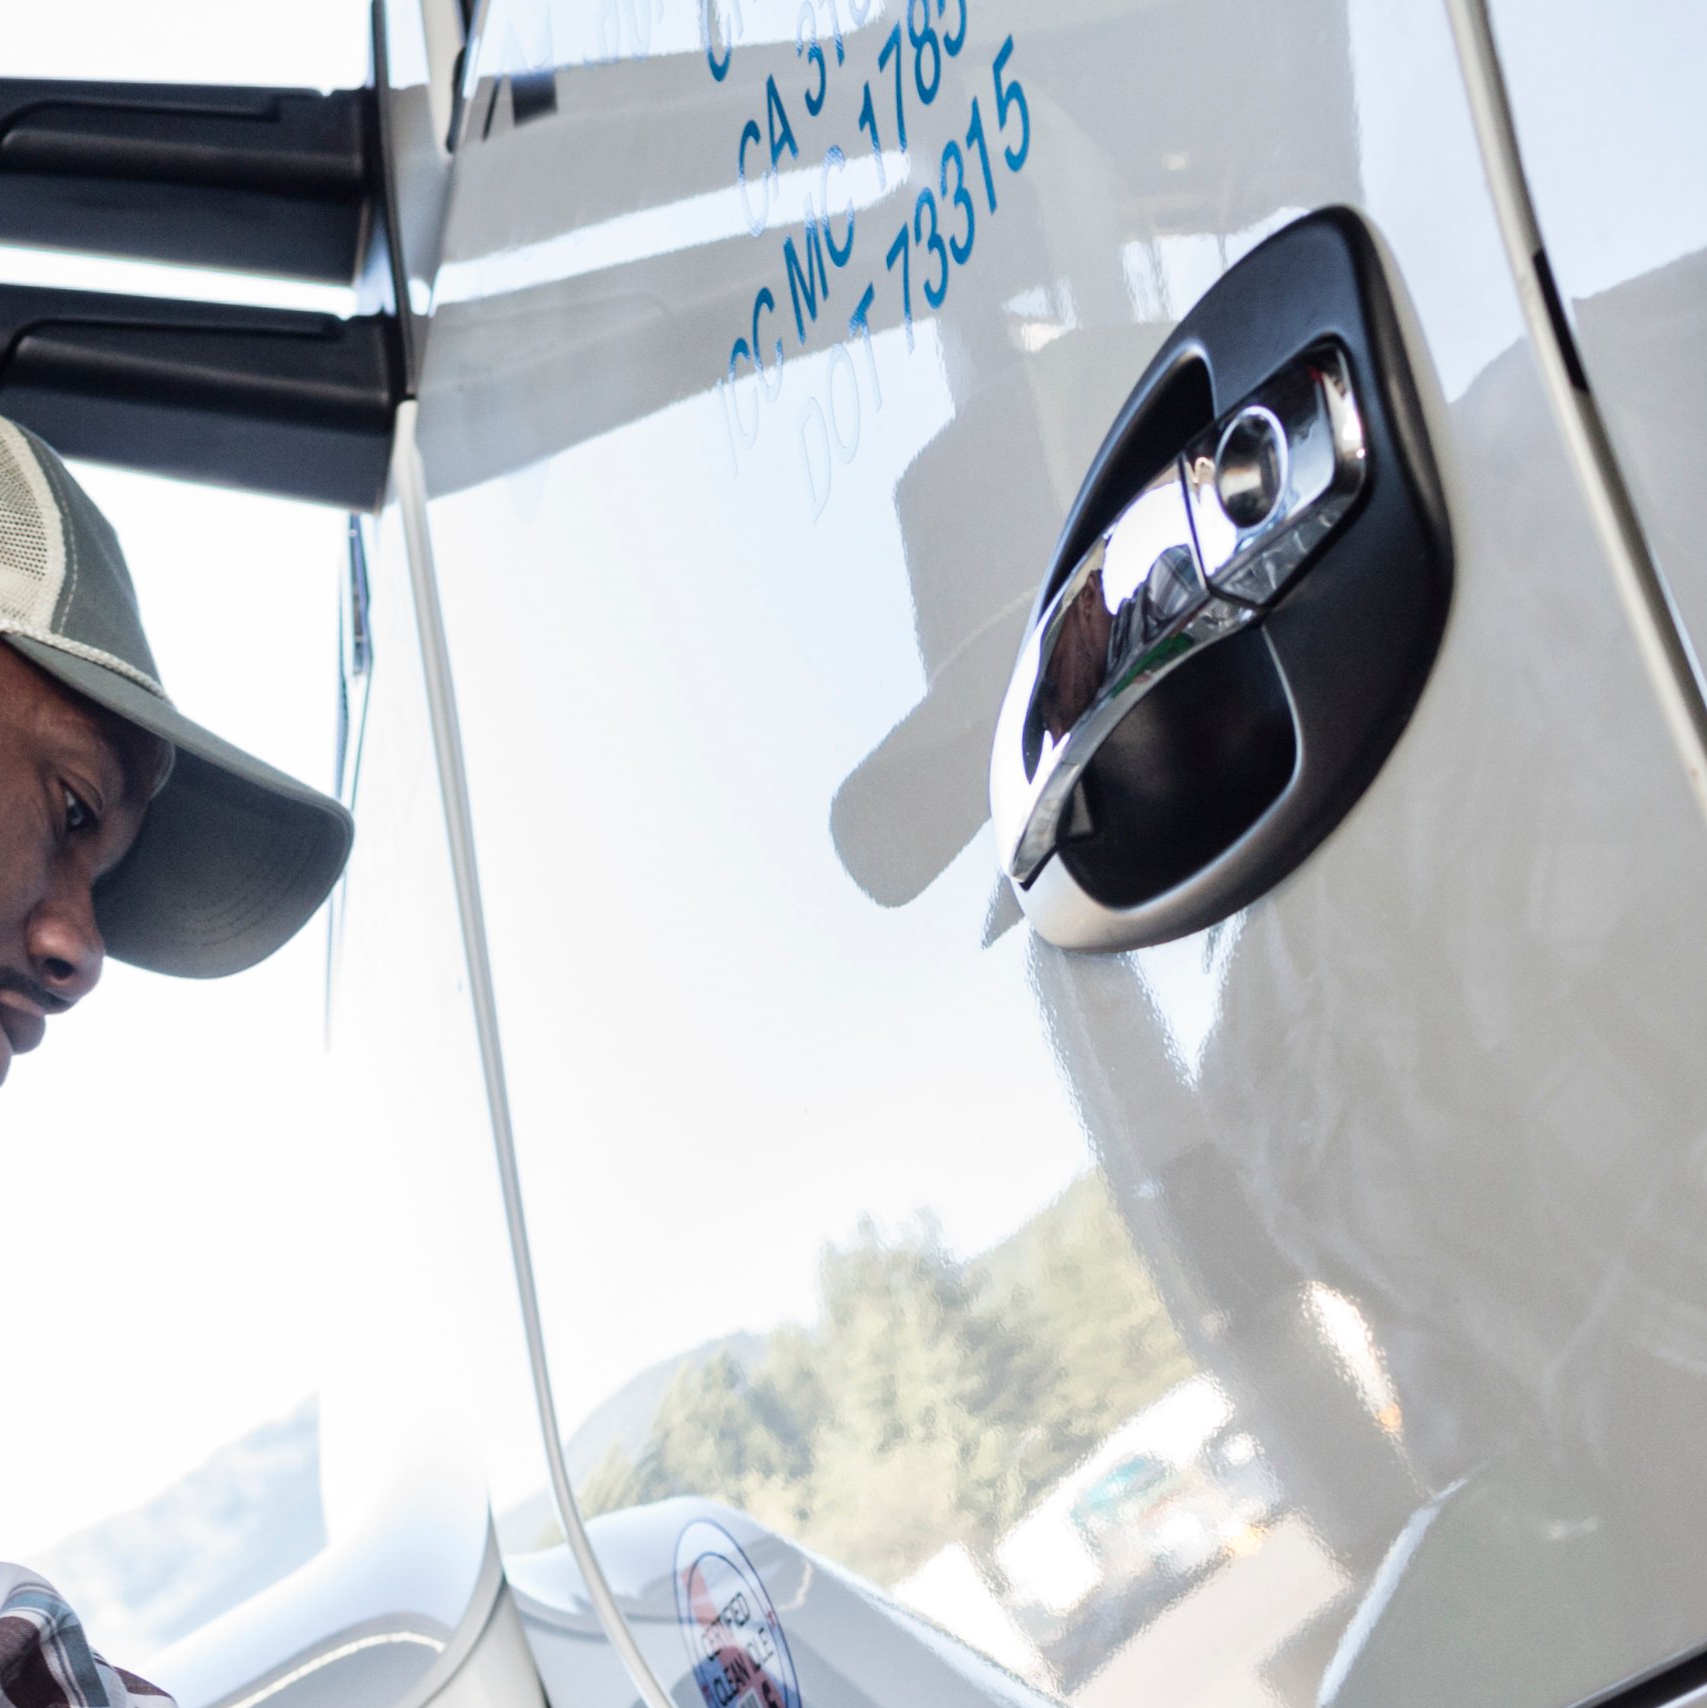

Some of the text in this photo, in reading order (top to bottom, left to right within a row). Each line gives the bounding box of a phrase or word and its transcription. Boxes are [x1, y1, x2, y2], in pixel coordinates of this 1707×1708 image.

[737, 74, 799, 237] CA
[782, 144, 855, 346] MC
[797, 33, 1031, 525] DOT 73315
[713, 1652, 751, 1707] CLEAN
